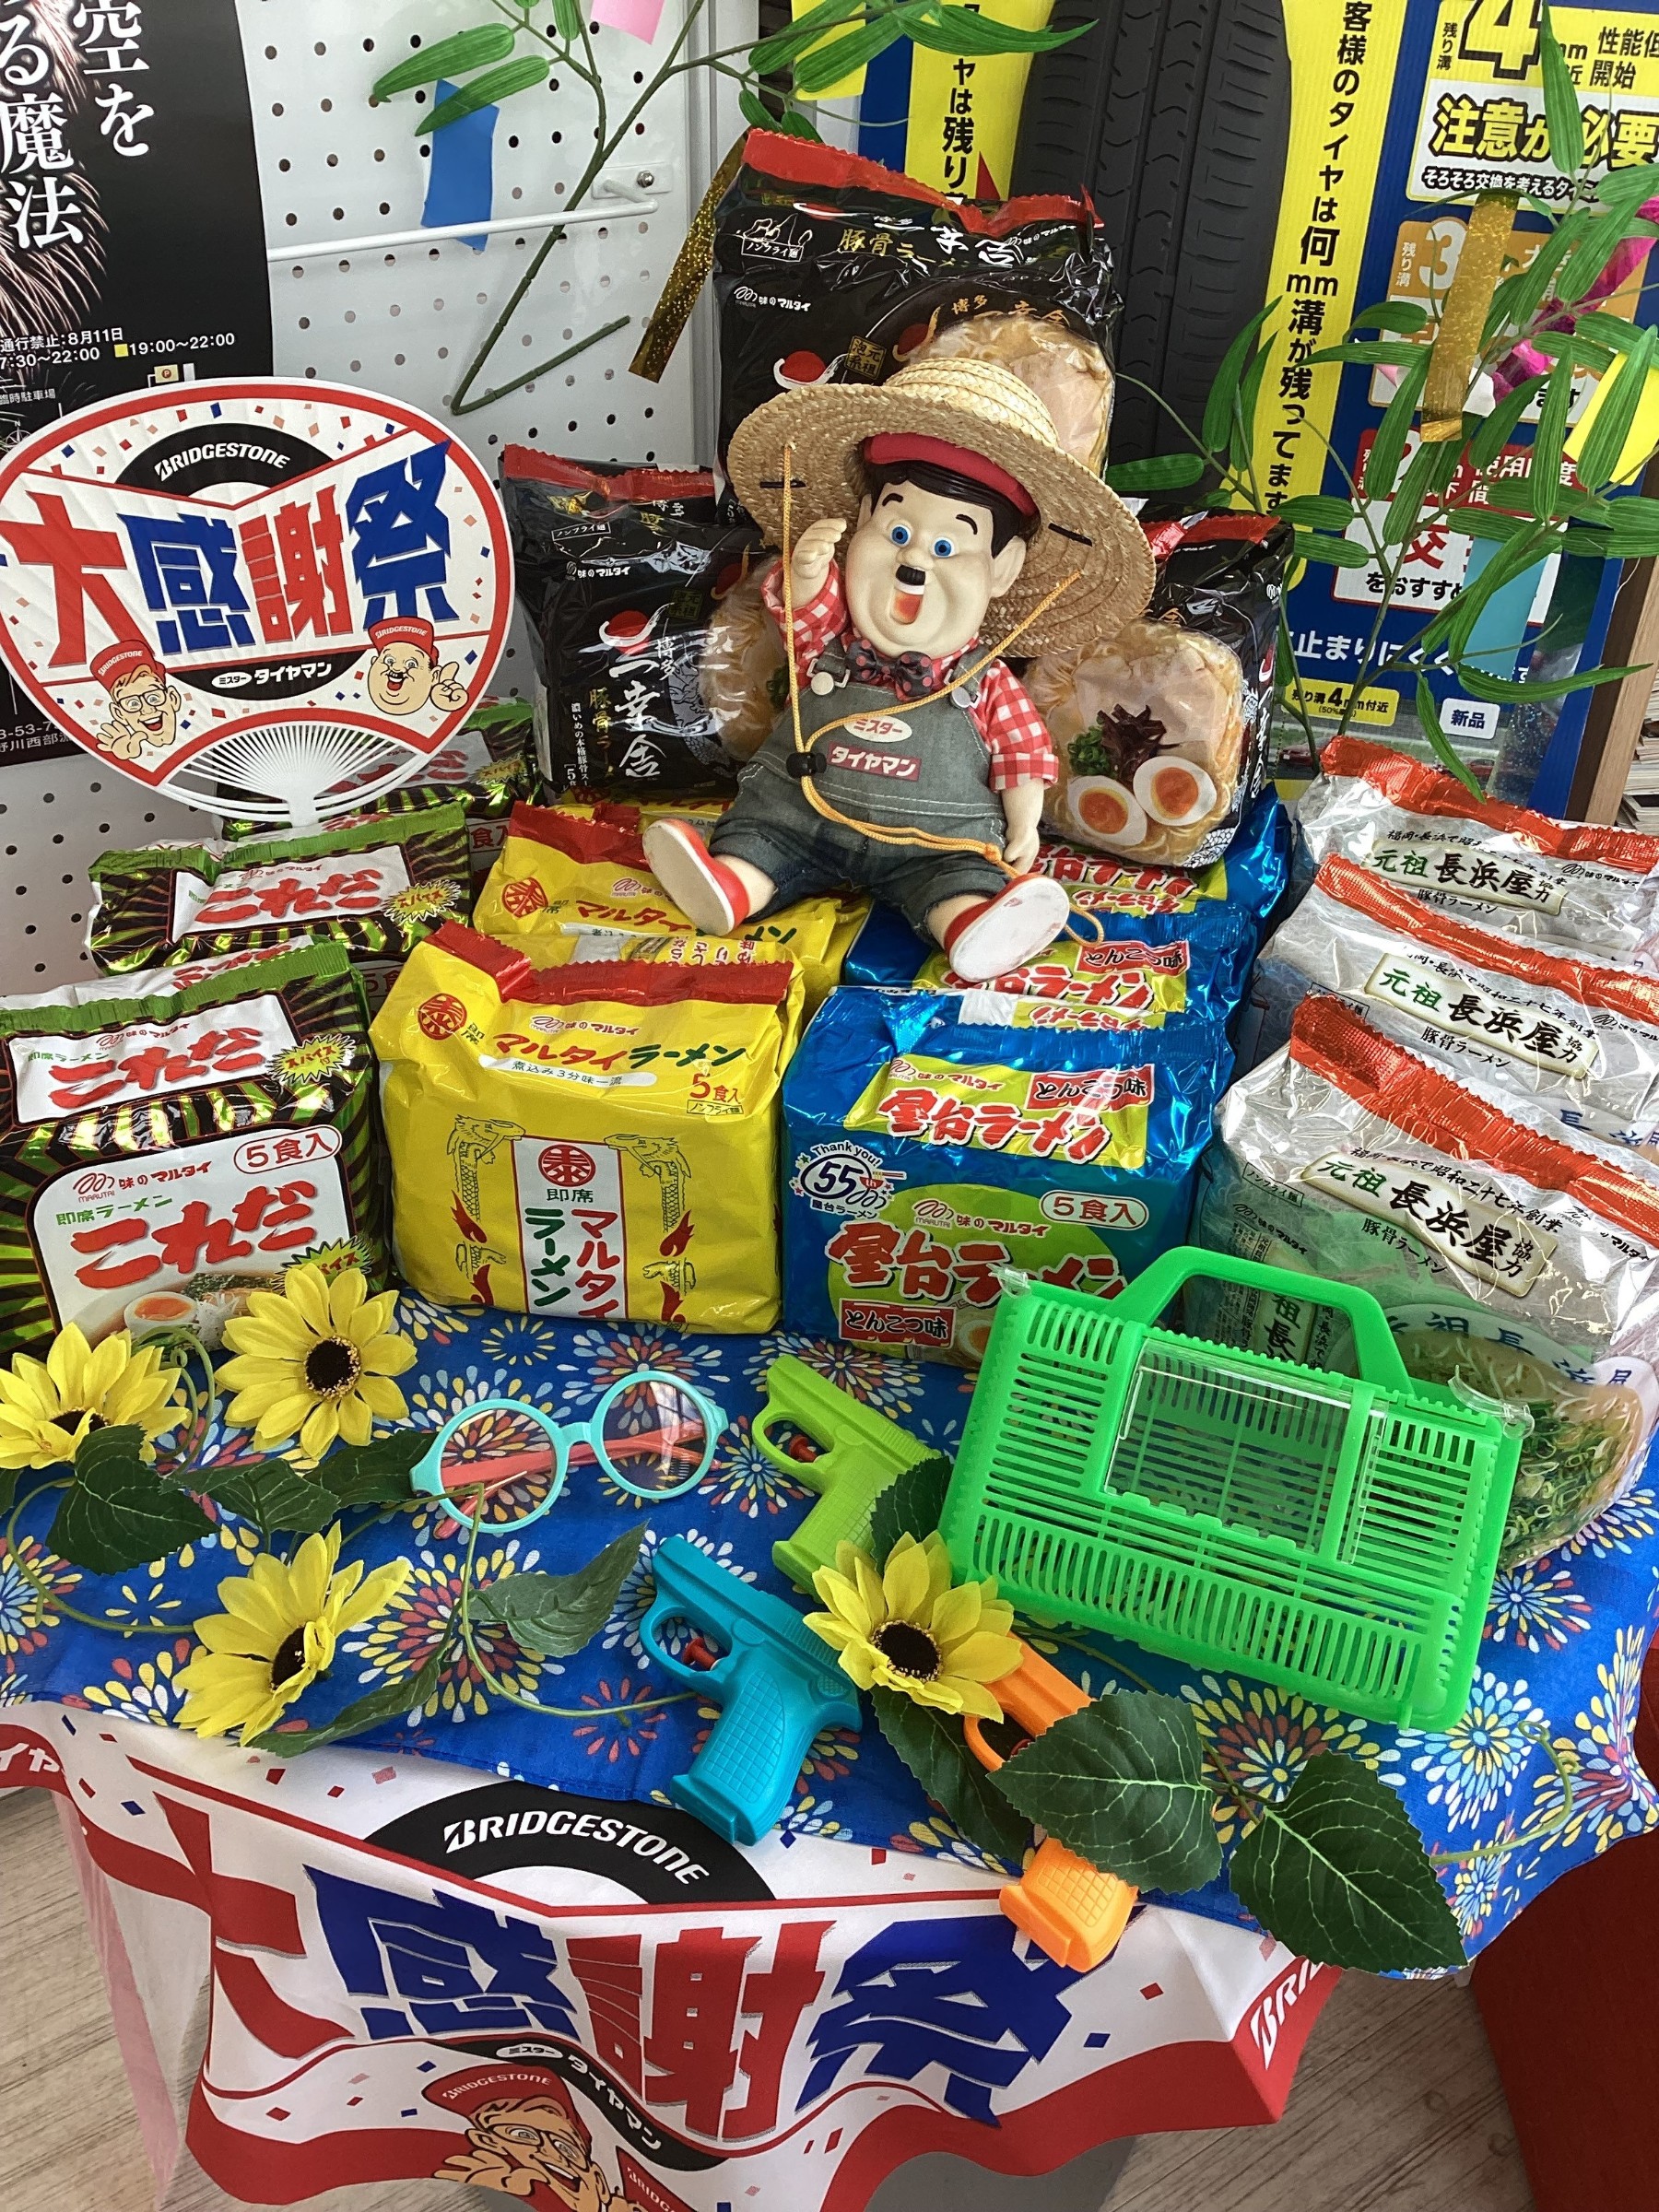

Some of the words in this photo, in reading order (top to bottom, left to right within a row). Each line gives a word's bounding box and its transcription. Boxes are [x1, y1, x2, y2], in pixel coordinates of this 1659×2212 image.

[1436, 23, 1457, 70] 残り溝
[74, 0, 154, 157] 空を
[1589, 60, 1637, 89] 開始
[942, 58, 976, 205] ヤは残り
[1394, 242, 1416, 287] 残り溝
[1419, 220, 1467, 290] 3
[759, 295, 812, 312] 味のマルタイ
[155, 442, 290, 480] BRIDGESTONE
[0, 441, 460, 668] 大感謝祭
[577, 566, 631, 579] 味のマルタイ
[375, 624, 428, 639] BRIDGESTONE
[99, 650, 143, 676] BRIDGESTONE
[253, 663, 332, 684] タイヤマン
[853, 719, 902, 735] ミスター
[1451, 710, 1486, 730] 新品
[831, 747, 916, 776] タイヤマン
[194, 869, 383, 922] これだ
[1417, 888, 1498, 913] 豚骨ラーメン
[564, 1019, 641, 1036] 味のマルタイ
[286, 1046, 336, 1069] スパイス
[493, 1033, 747, 1071] マルタイラーメン
[1420, 1026, 1511, 1068] 豚骨ラーメン
[49, 1027, 265, 1109] これだ
[916, 1072, 1006, 1092] 味のマルタイ
[689, 1074, 741, 1104] 5食入
[878, 1088, 1111, 1162] 屋台ラーメン
[245, 1133, 333, 1169] 5食入
[812, 1142, 853, 1156] Thank
[855, 1147, 882, 1168] you!
[119, 1161, 212, 1190] 味のマルタイ
[56, 1194, 172, 1226] 即席ラーメン
[547, 1188, 594, 1204] 即席
[956, 1216, 1052, 1238] 味のマルタイ
[1052, 1197, 1137, 1227] 5食入
[71, 1180, 316, 1289] これだ
[1361, 1218, 1447, 1275] 豚骨ラーメン
[524, 1207, 571, 1307] ラーメン
[571, 1208, 621, 1319] マルタイ
[845, 1309, 948, 1339] とんこつ味
[443, 1808, 712, 1886] BRIDGESTONE
[442, 2073, 552, 2100] BRIDGESTONE
[568, 2053, 662, 2150] タイヤマン
